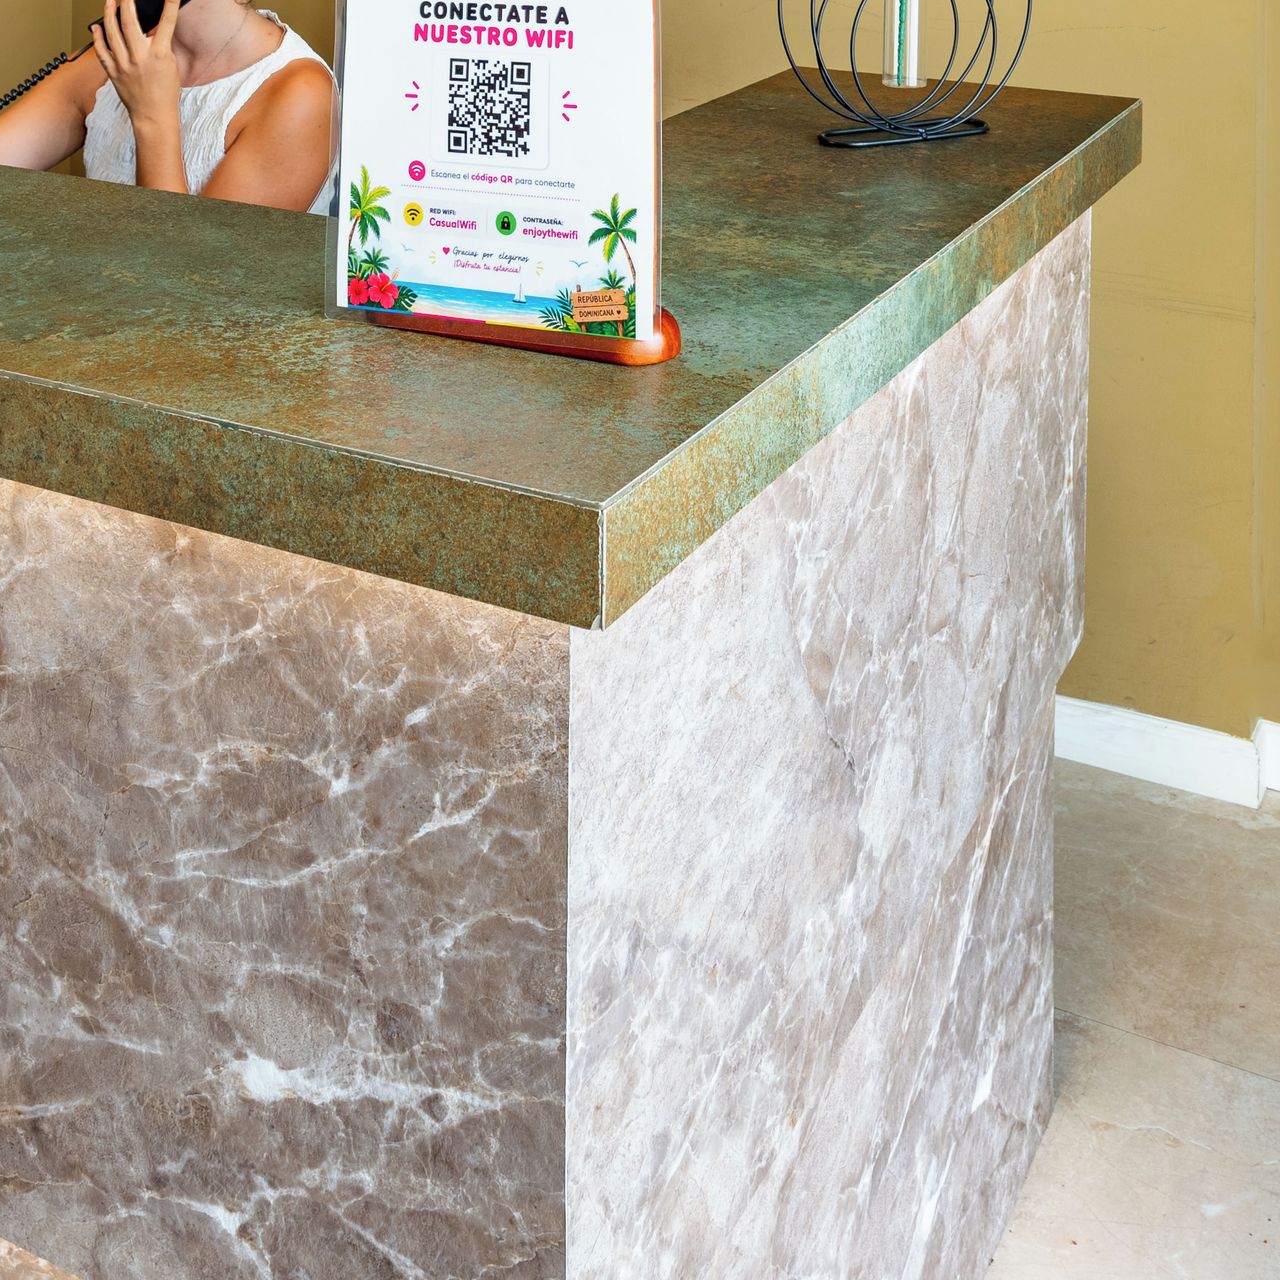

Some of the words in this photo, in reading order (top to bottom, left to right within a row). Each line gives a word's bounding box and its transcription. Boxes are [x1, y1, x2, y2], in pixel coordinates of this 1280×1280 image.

[419, 0, 548, 24] CONECTATE
[554, 6, 570, 25] A
[413, 23, 518, 46] NUESTRO
[525, 28, 574, 49] WIFI
[430, 169, 461, 179] Escanea
[462, 172, 470, 180] el
[471, 172, 498, 184] código
[500, 174, 513, 184] QR
[515, 177, 533, 186] para
[534, 179, 576, 189] conectarte
[429, 207, 442, 215] RED
[429, 217, 477, 230] CasualWifi
[522, 227, 578, 240] enjoythewifi
[452, 246, 479, 257] Gracias
[482, 252, 493, 260] por
[498, 252, 531, 264] elegirnos
[483, 263, 491, 271] tu
[577, 294, 613, 304] REPÚBLICA
[579, 309, 615, 318] DOMINICANA
